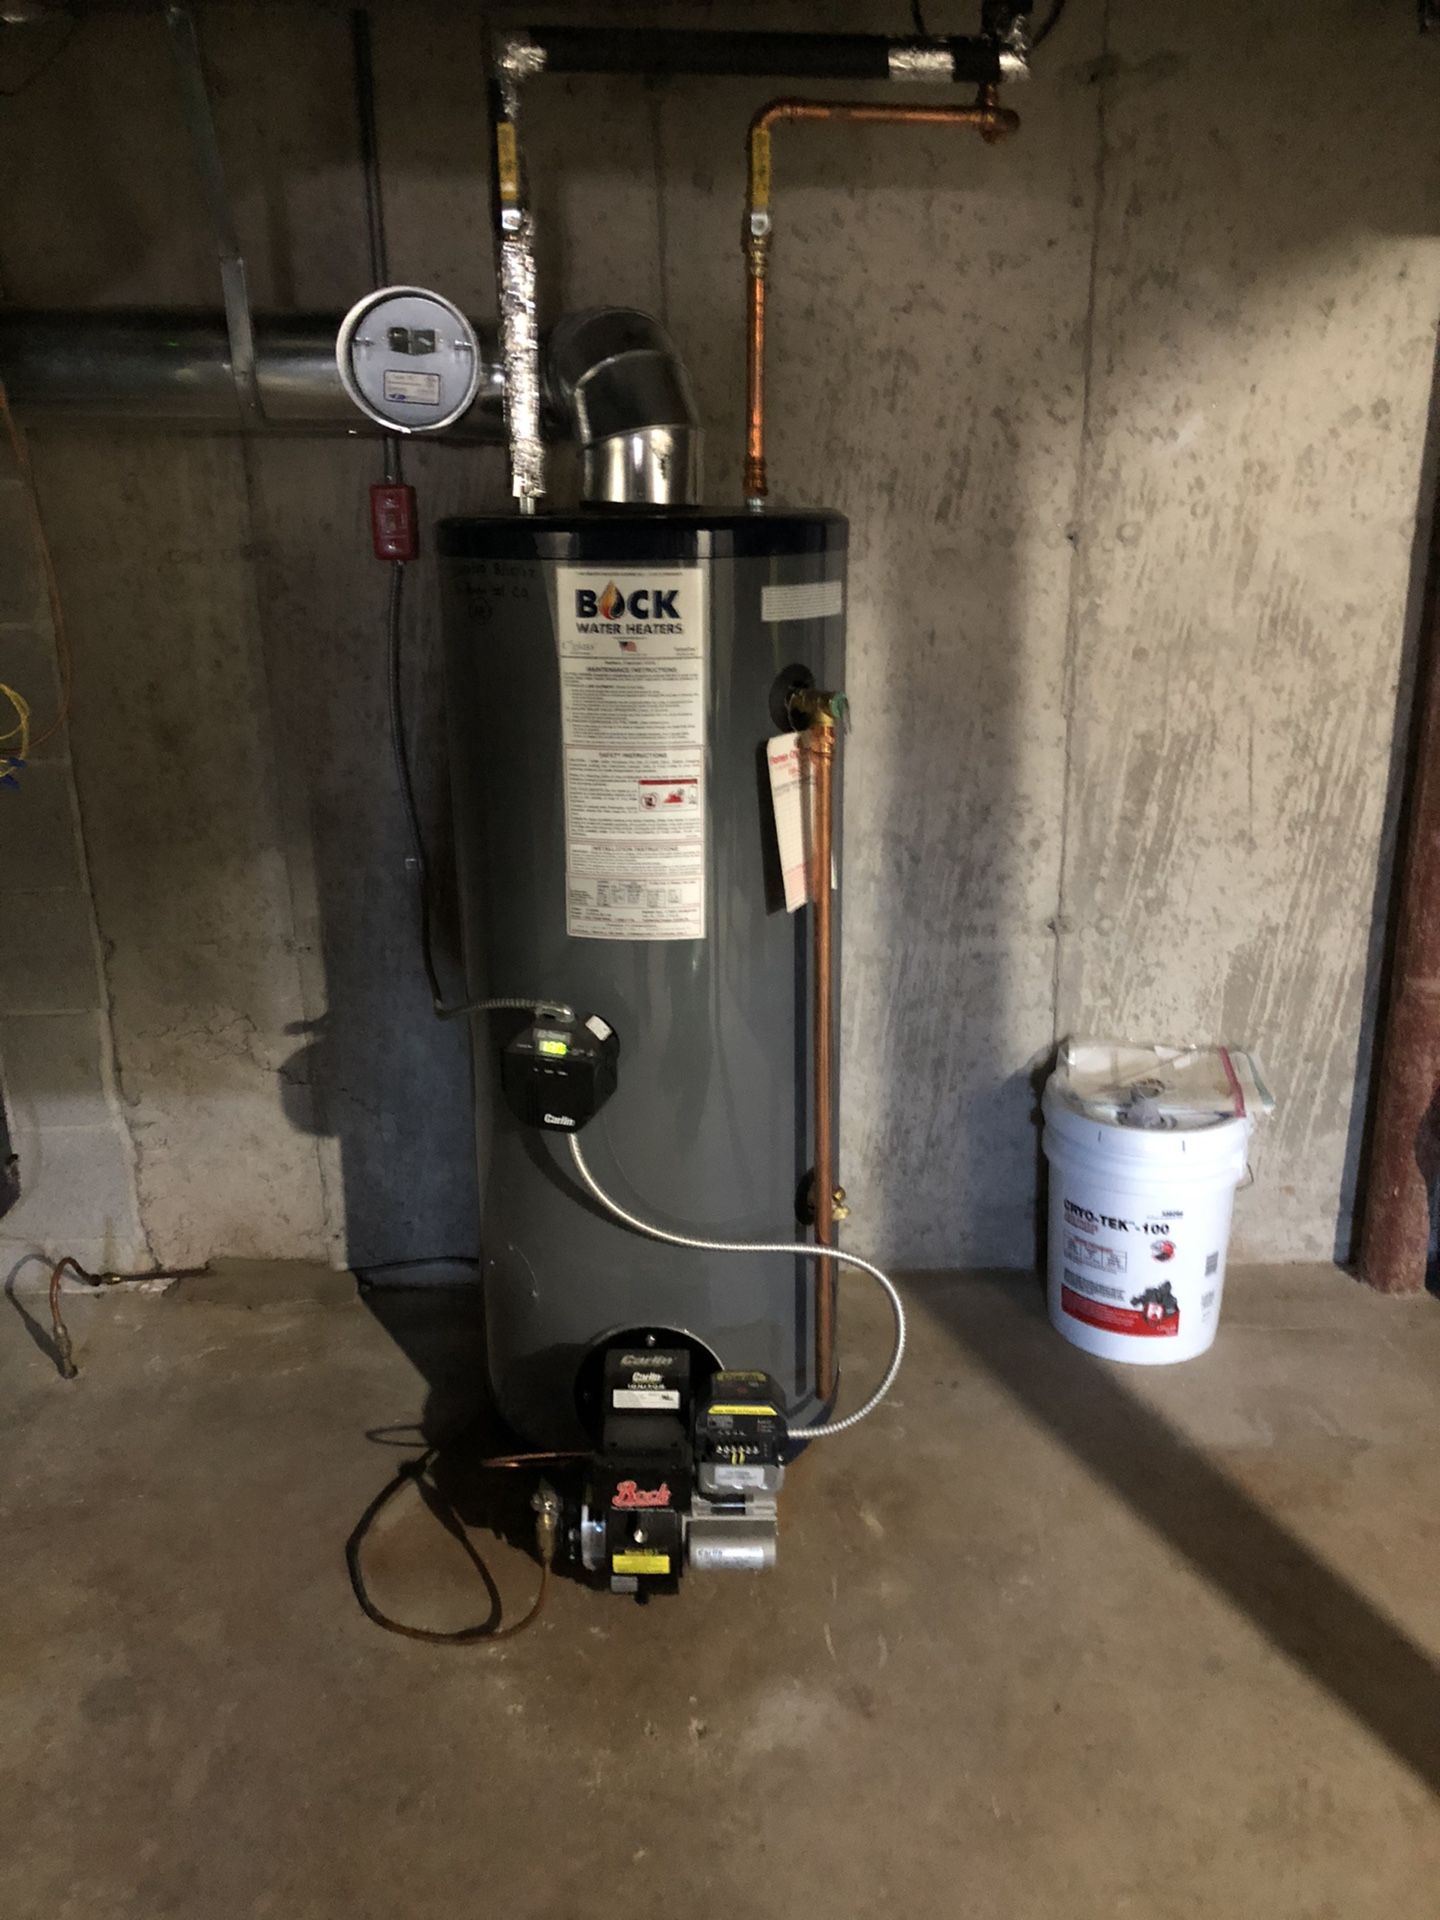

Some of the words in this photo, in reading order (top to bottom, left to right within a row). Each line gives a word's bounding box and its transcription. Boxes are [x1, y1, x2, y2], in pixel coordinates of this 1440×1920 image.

[575, 580, 681, 620] BOCK
[576, 623, 621, 635] WATER
[626, 623, 682, 635] HEATERS
[544, 1113, 575, 1126] Carlin
[611, 1480, 672, 1507] Bock
